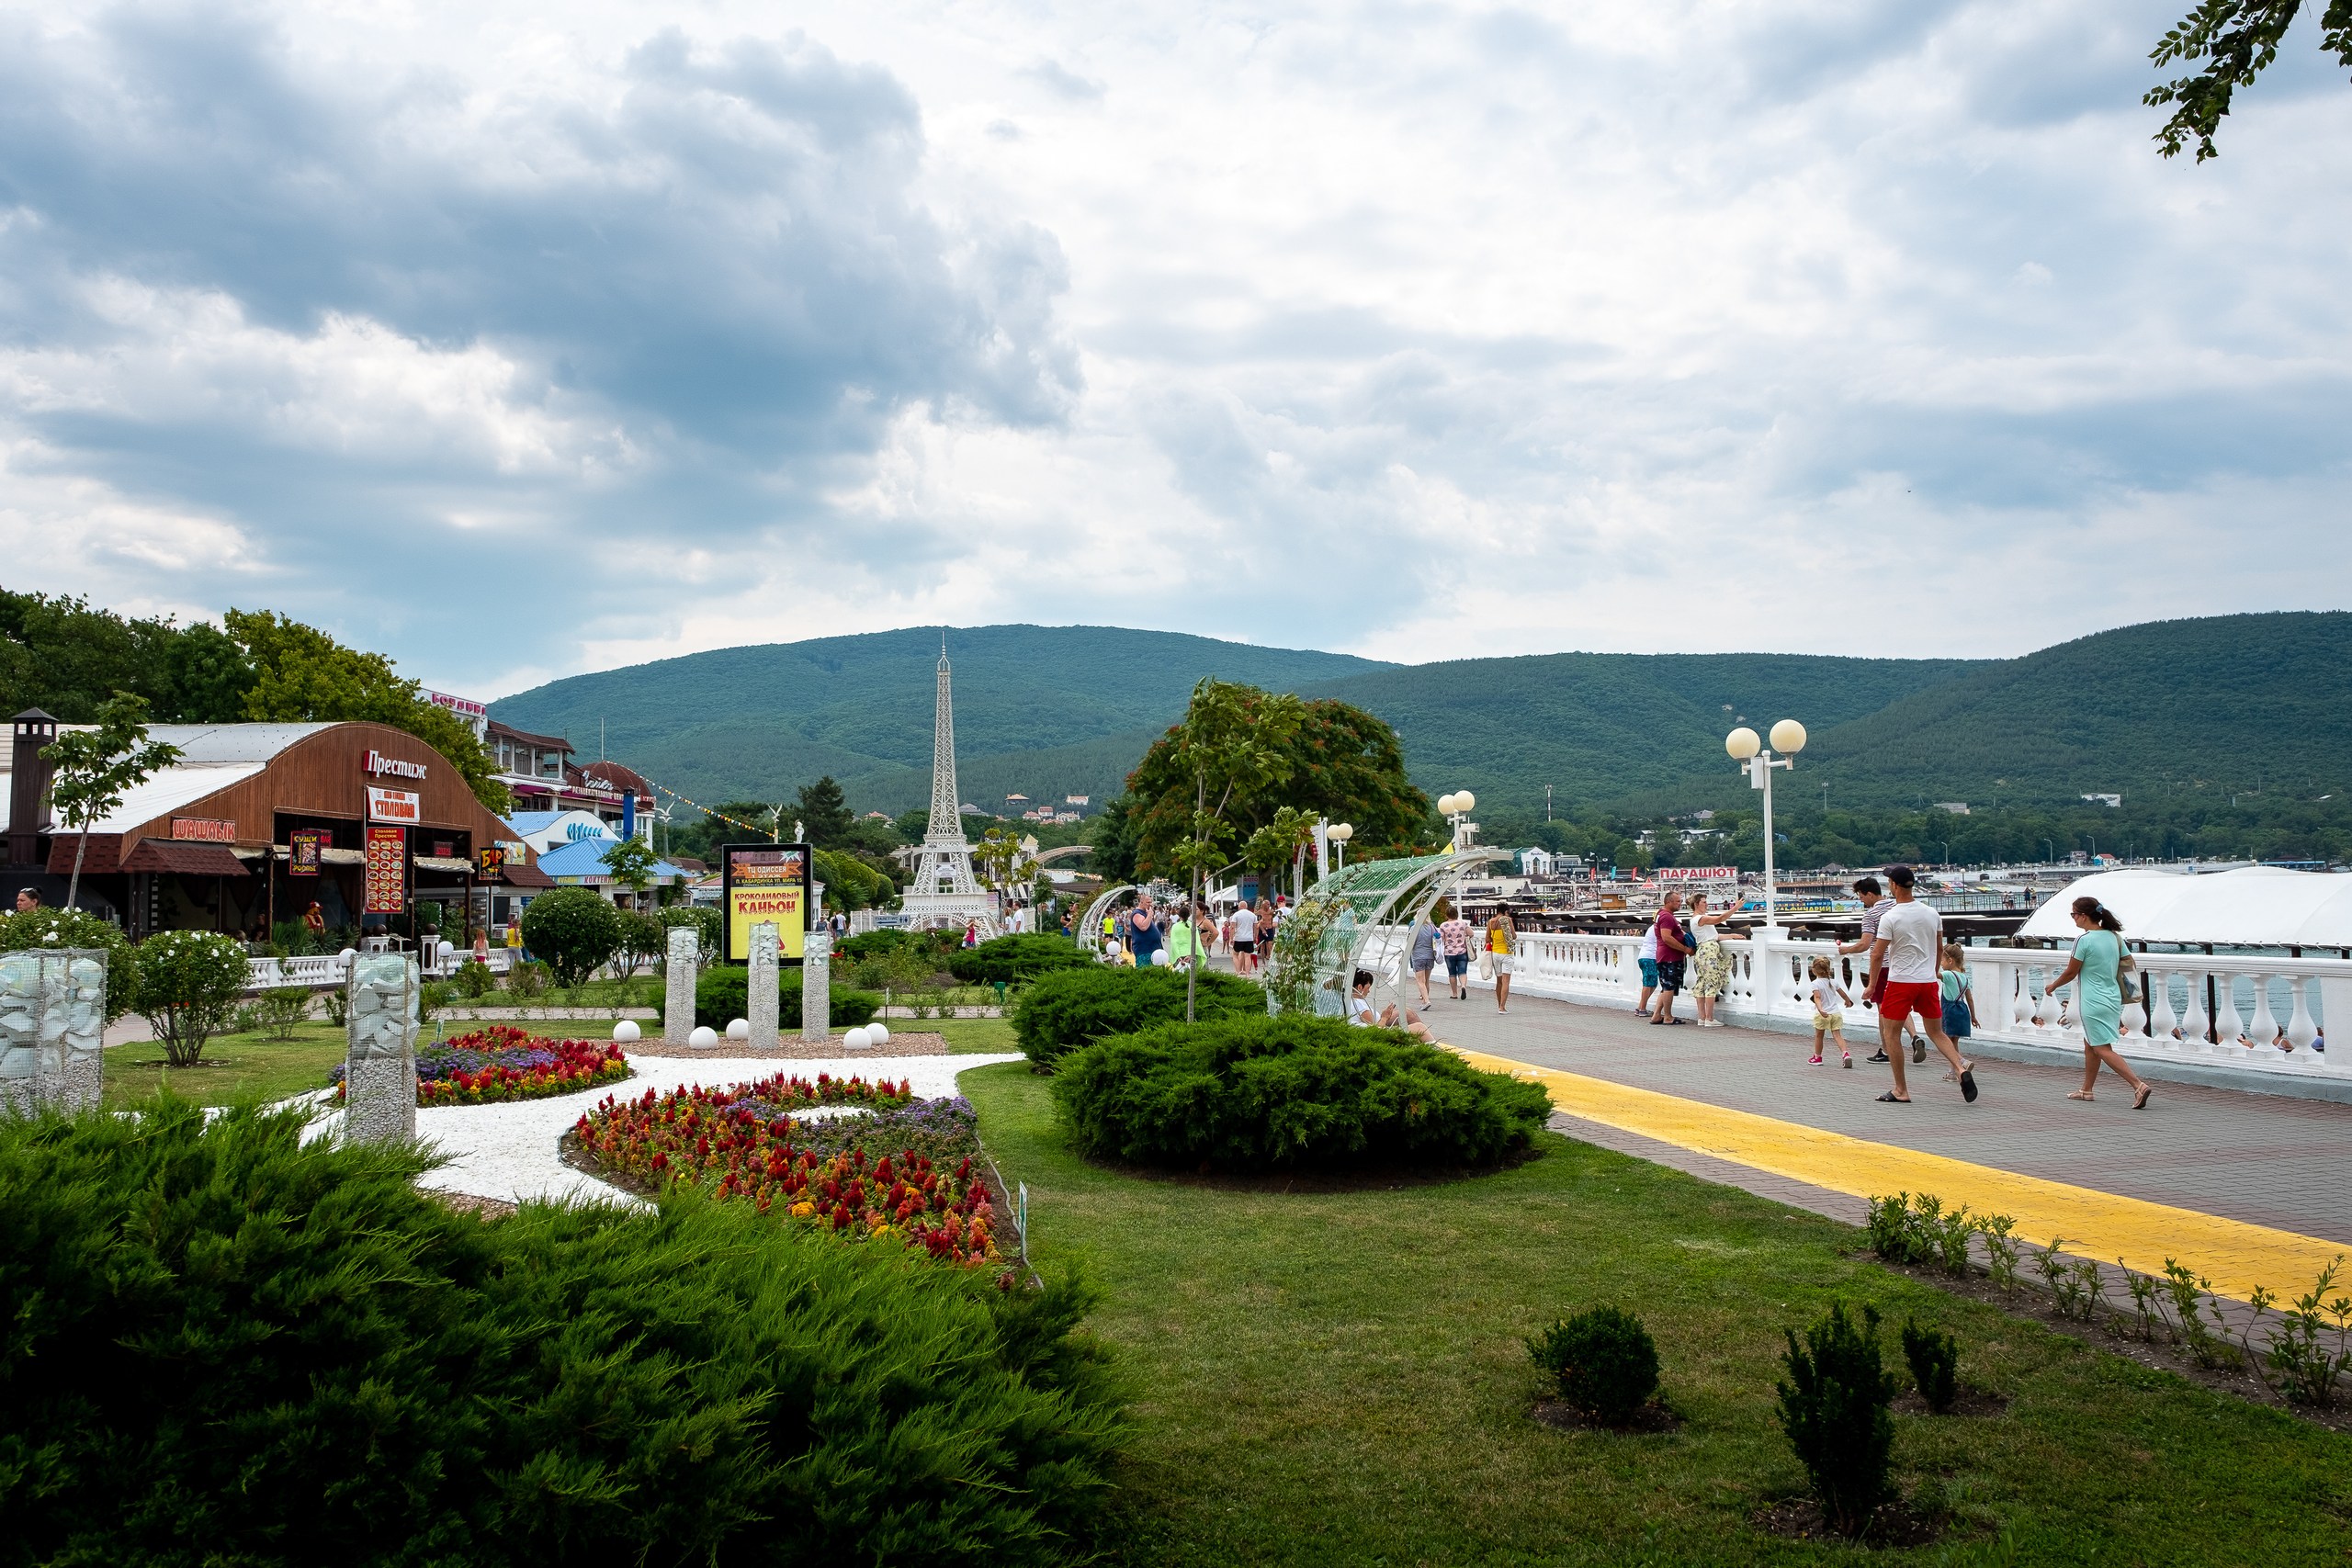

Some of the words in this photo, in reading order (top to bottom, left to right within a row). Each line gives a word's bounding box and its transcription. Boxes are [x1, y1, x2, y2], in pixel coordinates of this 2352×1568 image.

[368, 750, 427, 780] Престиж
[375, 800, 415, 818] СТОЛОВАЯ
[173, 819, 236, 840] ШАШЛЫК
[481, 849, 503, 868] БАР
[1660, 868, 1736, 878] ПАРАШЮТ
[735, 891, 800, 900] КРОКОДИЛОВЫЙ
[738, 901, 796, 914] КАНЬОН
